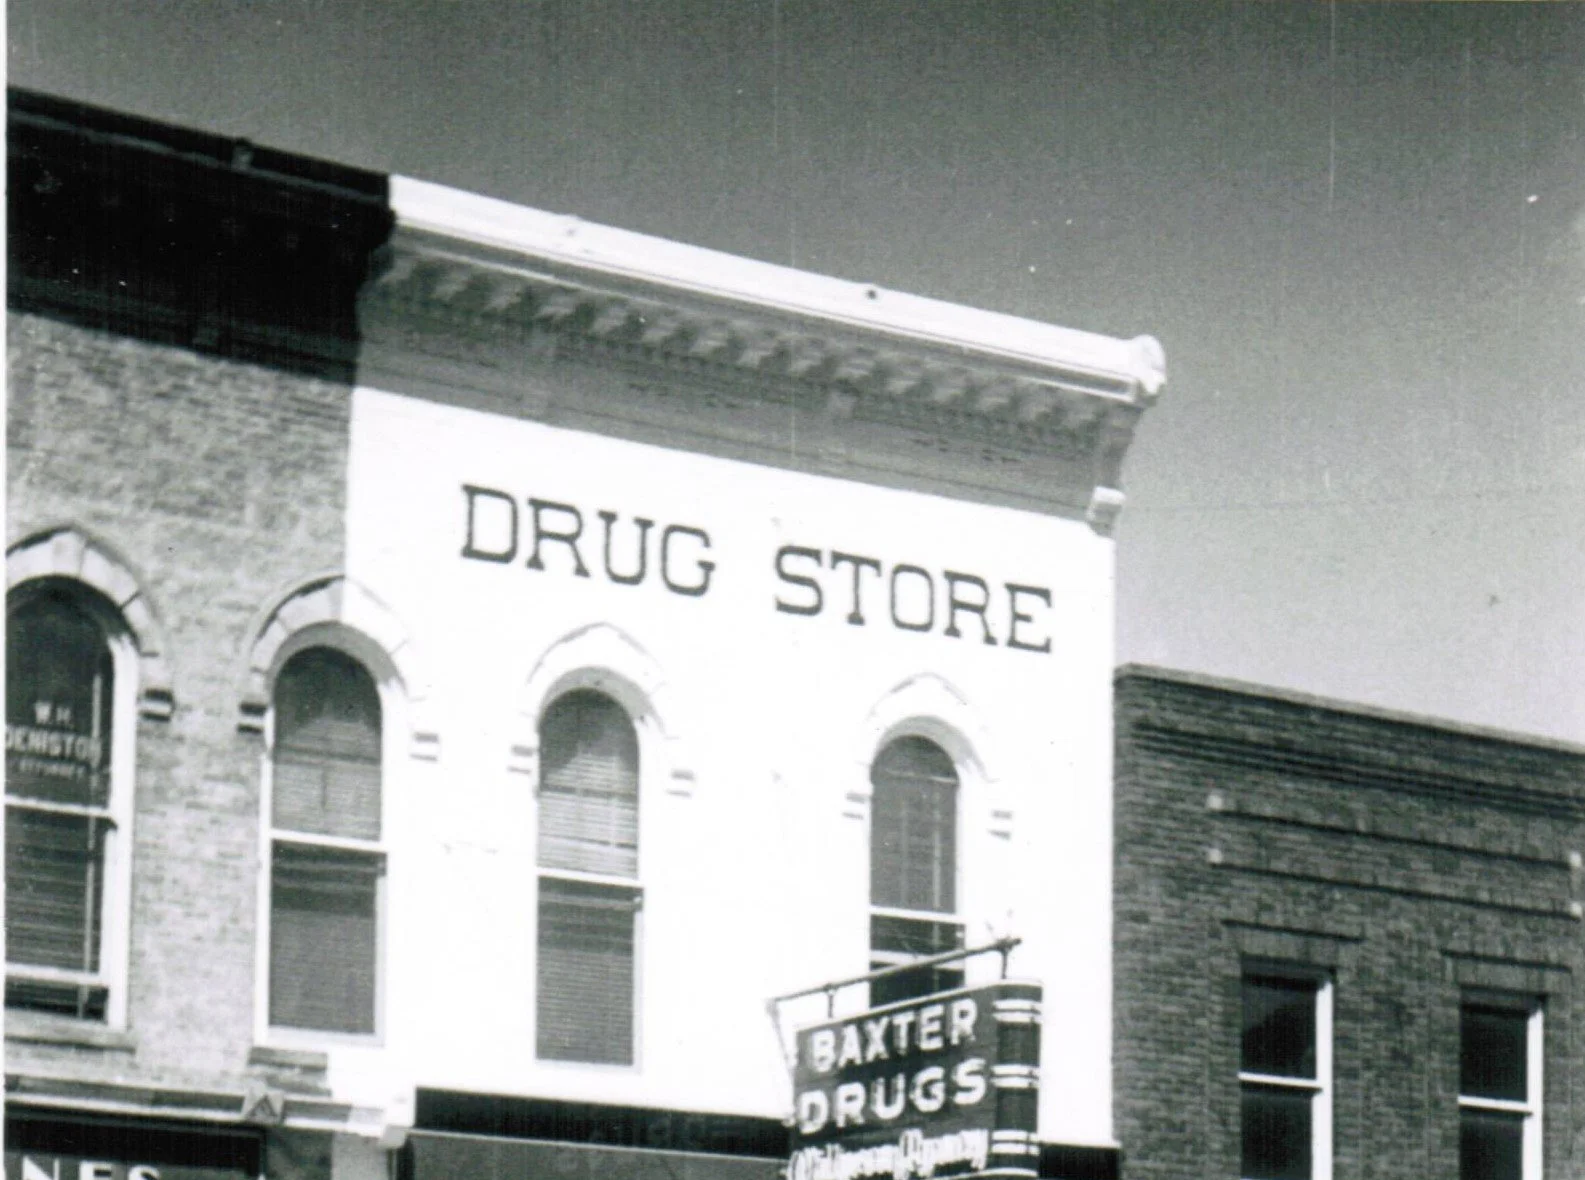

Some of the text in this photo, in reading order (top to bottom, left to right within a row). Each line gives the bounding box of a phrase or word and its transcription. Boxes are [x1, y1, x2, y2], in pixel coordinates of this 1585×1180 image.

[461, 483, 1053, 653] DRUG STORE
[811, 998, 977, 1073] BAXTER
[799, 1058, 988, 1135] DRUGS
